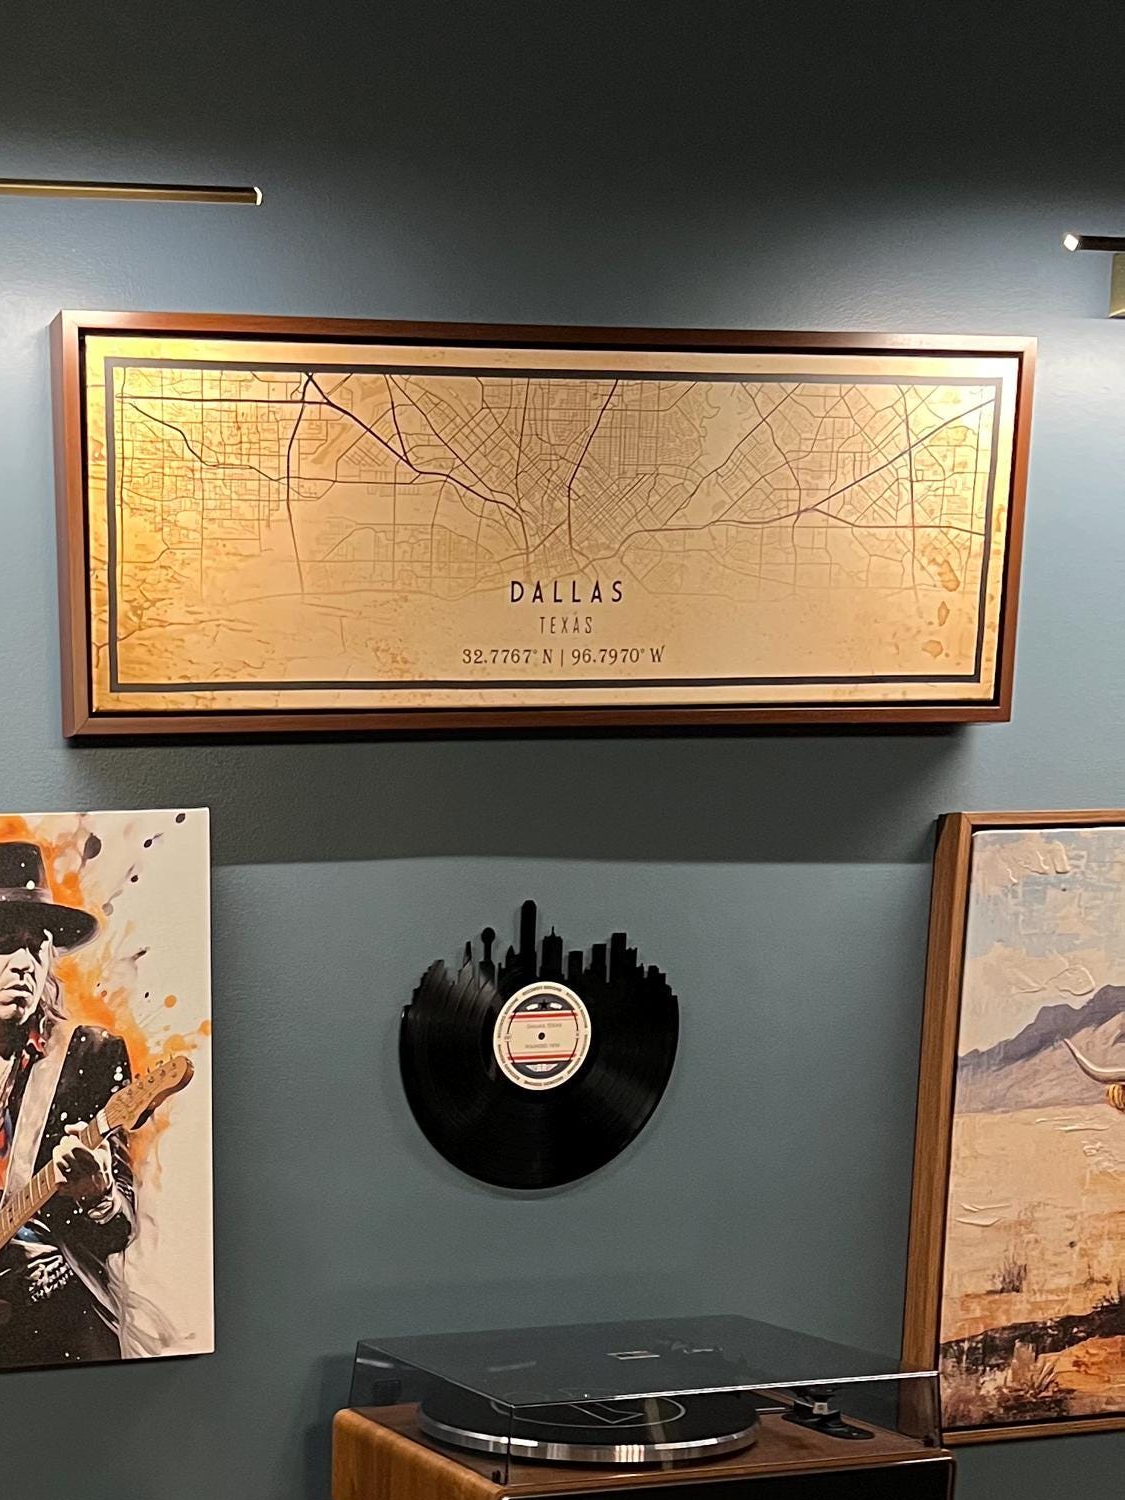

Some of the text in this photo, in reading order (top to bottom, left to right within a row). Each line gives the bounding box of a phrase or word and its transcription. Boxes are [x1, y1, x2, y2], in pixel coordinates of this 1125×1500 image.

[510, 580, 623, 603] DALLAS
[539, 616, 593, 634] TEXAS
[462, 648, 538, 664] 32.7767°
[542, 649, 553, 664] N
[571, 648, 645, 665] 96.7970°
[649, 645, 666, 663] W
